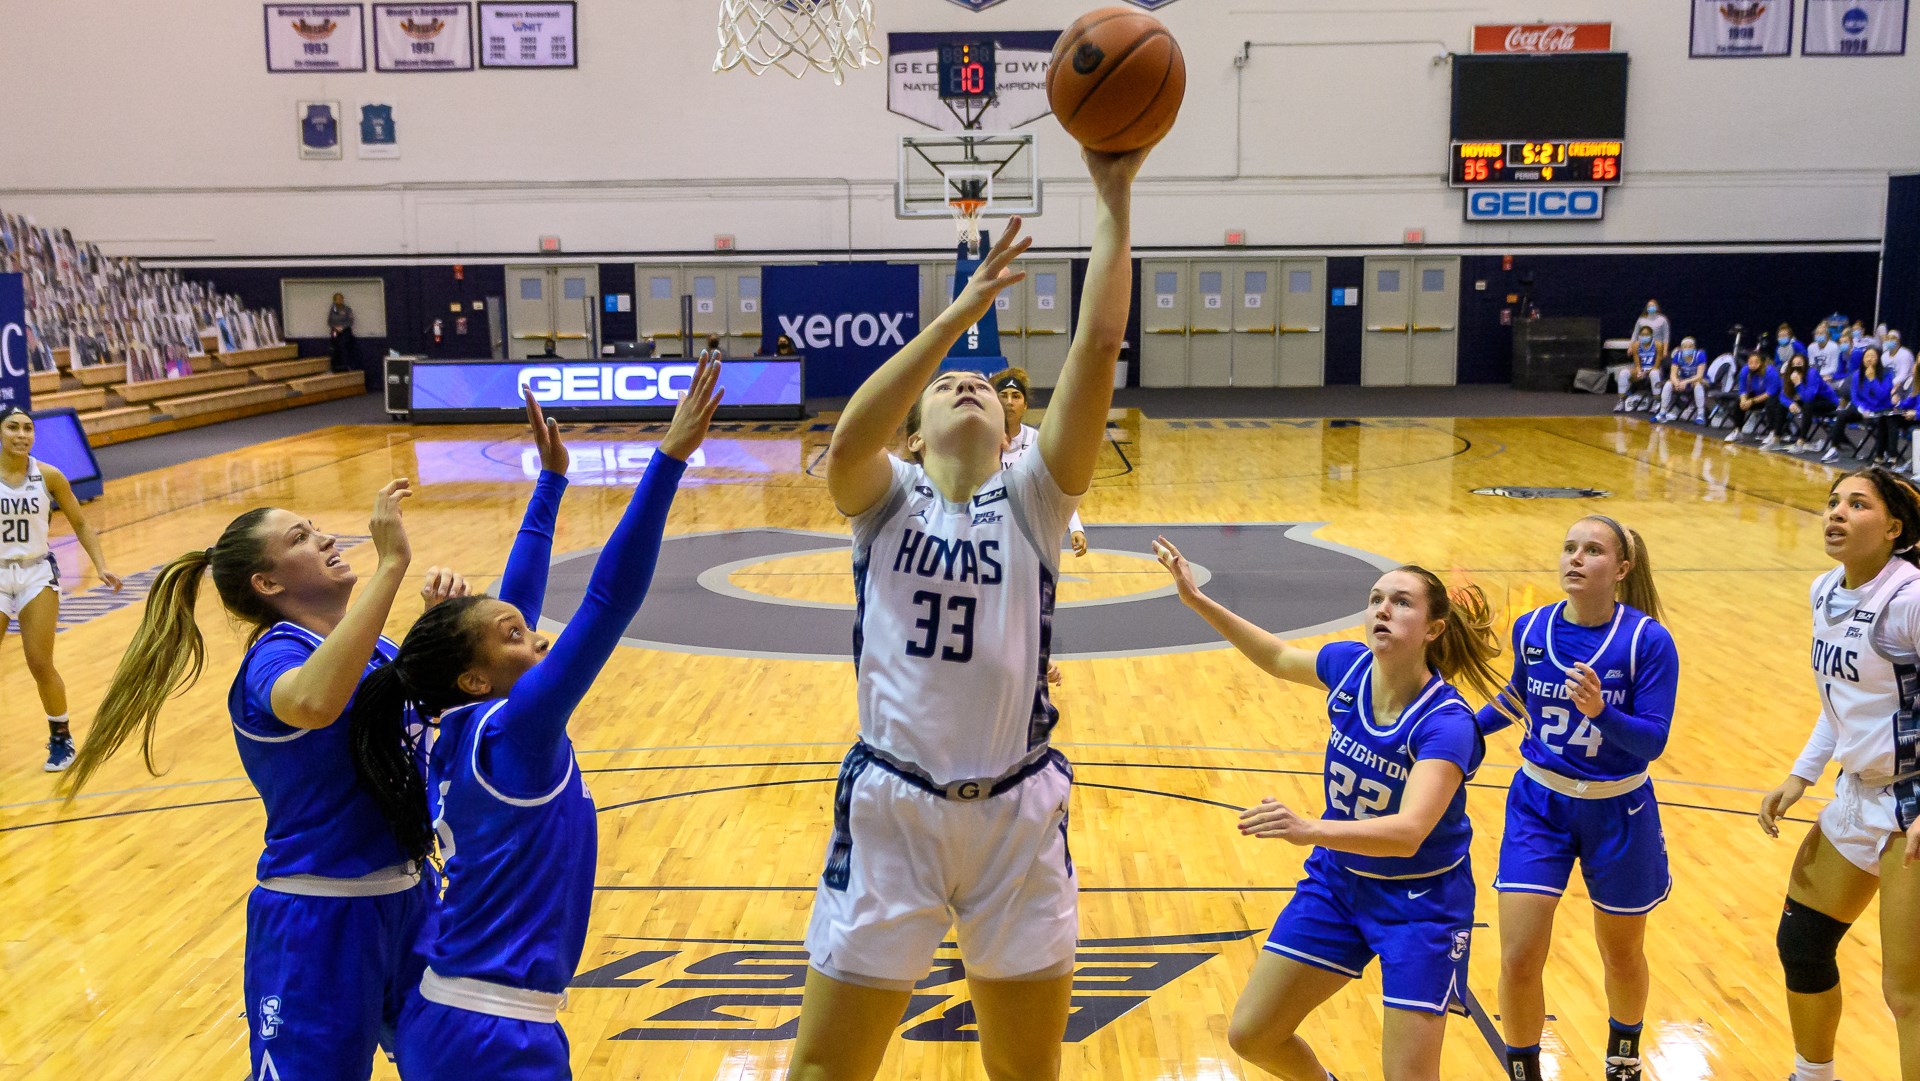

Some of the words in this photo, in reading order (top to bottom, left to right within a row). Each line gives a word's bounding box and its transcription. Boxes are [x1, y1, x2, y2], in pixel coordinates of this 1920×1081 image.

[961, 62, 984, 93] 10
[1461, 143, 1502, 158] HOYAS
[1522, 142, 1565, 165] 5:21
[1568, 142, 1621, 157] CREIGHTON
[1464, 159, 1488, 181] 35
[1541, 166, 1553, 181] 4
[1592, 157, 1617, 180] 35
[1471, 191, 1599, 217] GEICO
[778, 313, 904, 349] xerox
[518, 366, 697, 401] GEICO
[0, 497, 40, 515] OYAS
[2, 519, 30, 543] 20
[893, 528, 1002, 585] HOYAS
[905, 590, 977, 663] 33
[1811, 637, 1860, 682] OYAS
[1540, 706, 1603, 757] 24
[957, 782, 980, 800] G
[1329, 761, 1392, 820] 22
